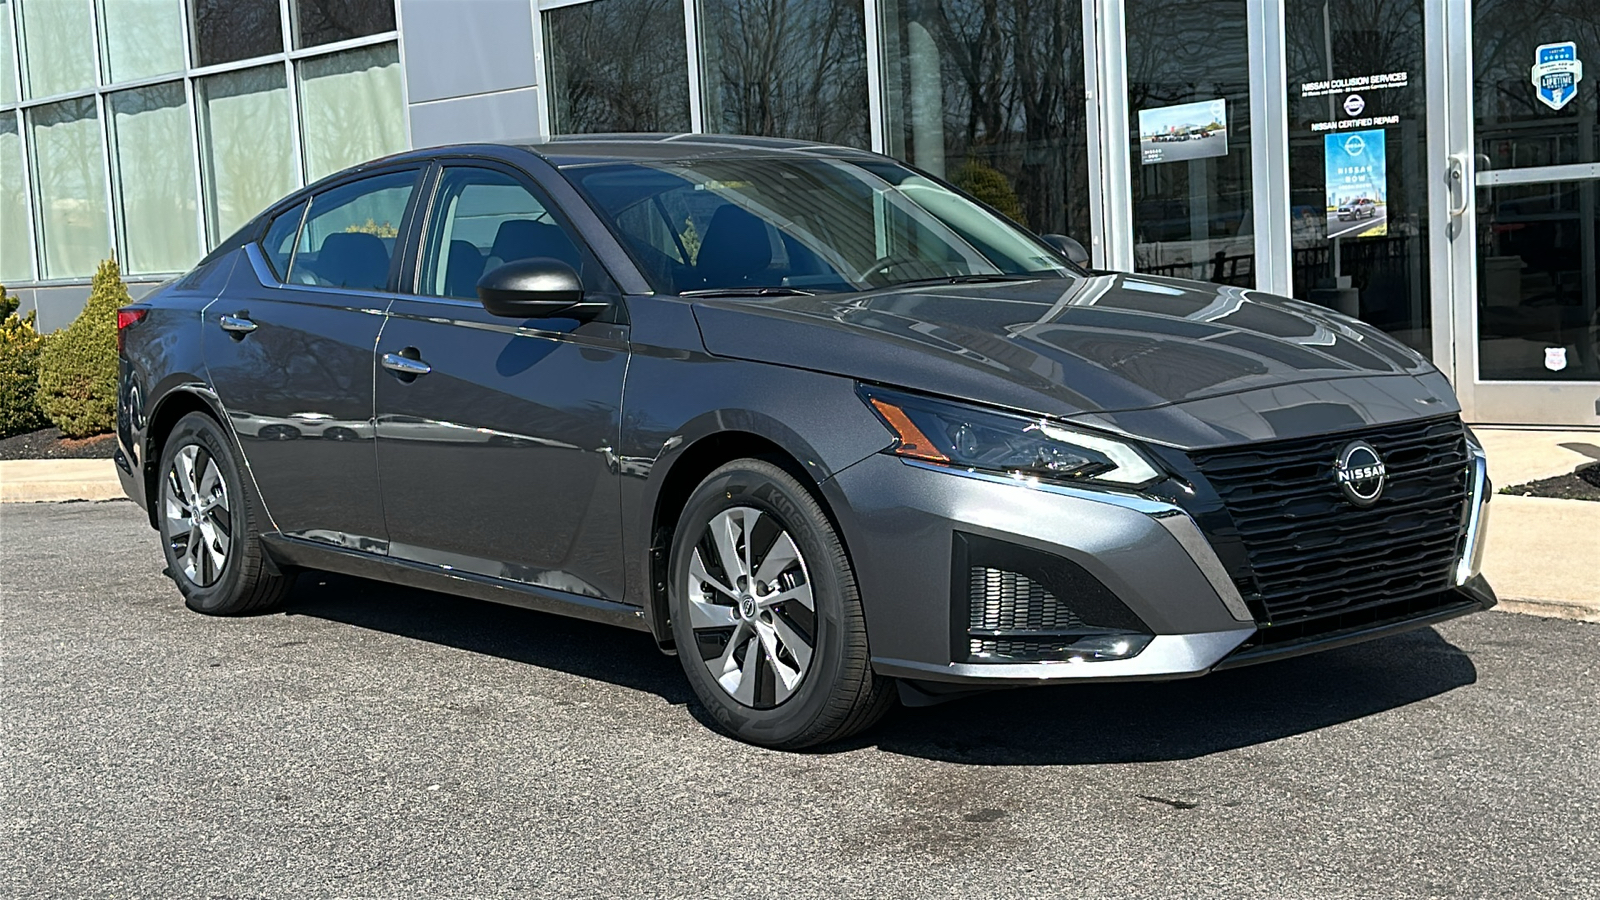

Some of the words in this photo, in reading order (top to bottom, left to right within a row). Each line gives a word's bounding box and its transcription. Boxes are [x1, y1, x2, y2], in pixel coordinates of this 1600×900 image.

[1302, 81, 1330, 91] NISSAN
[1331, 76, 1369, 89] COLLISION
[1370, 72, 1407, 84] SERVICES
[1311, 121, 1337, 131] NISSAN
[1338, 118, 1372, 128] CERTIFIED
[1373, 115, 1399, 125] REPAIR
[1339, 465, 1385, 481] NISSAN
